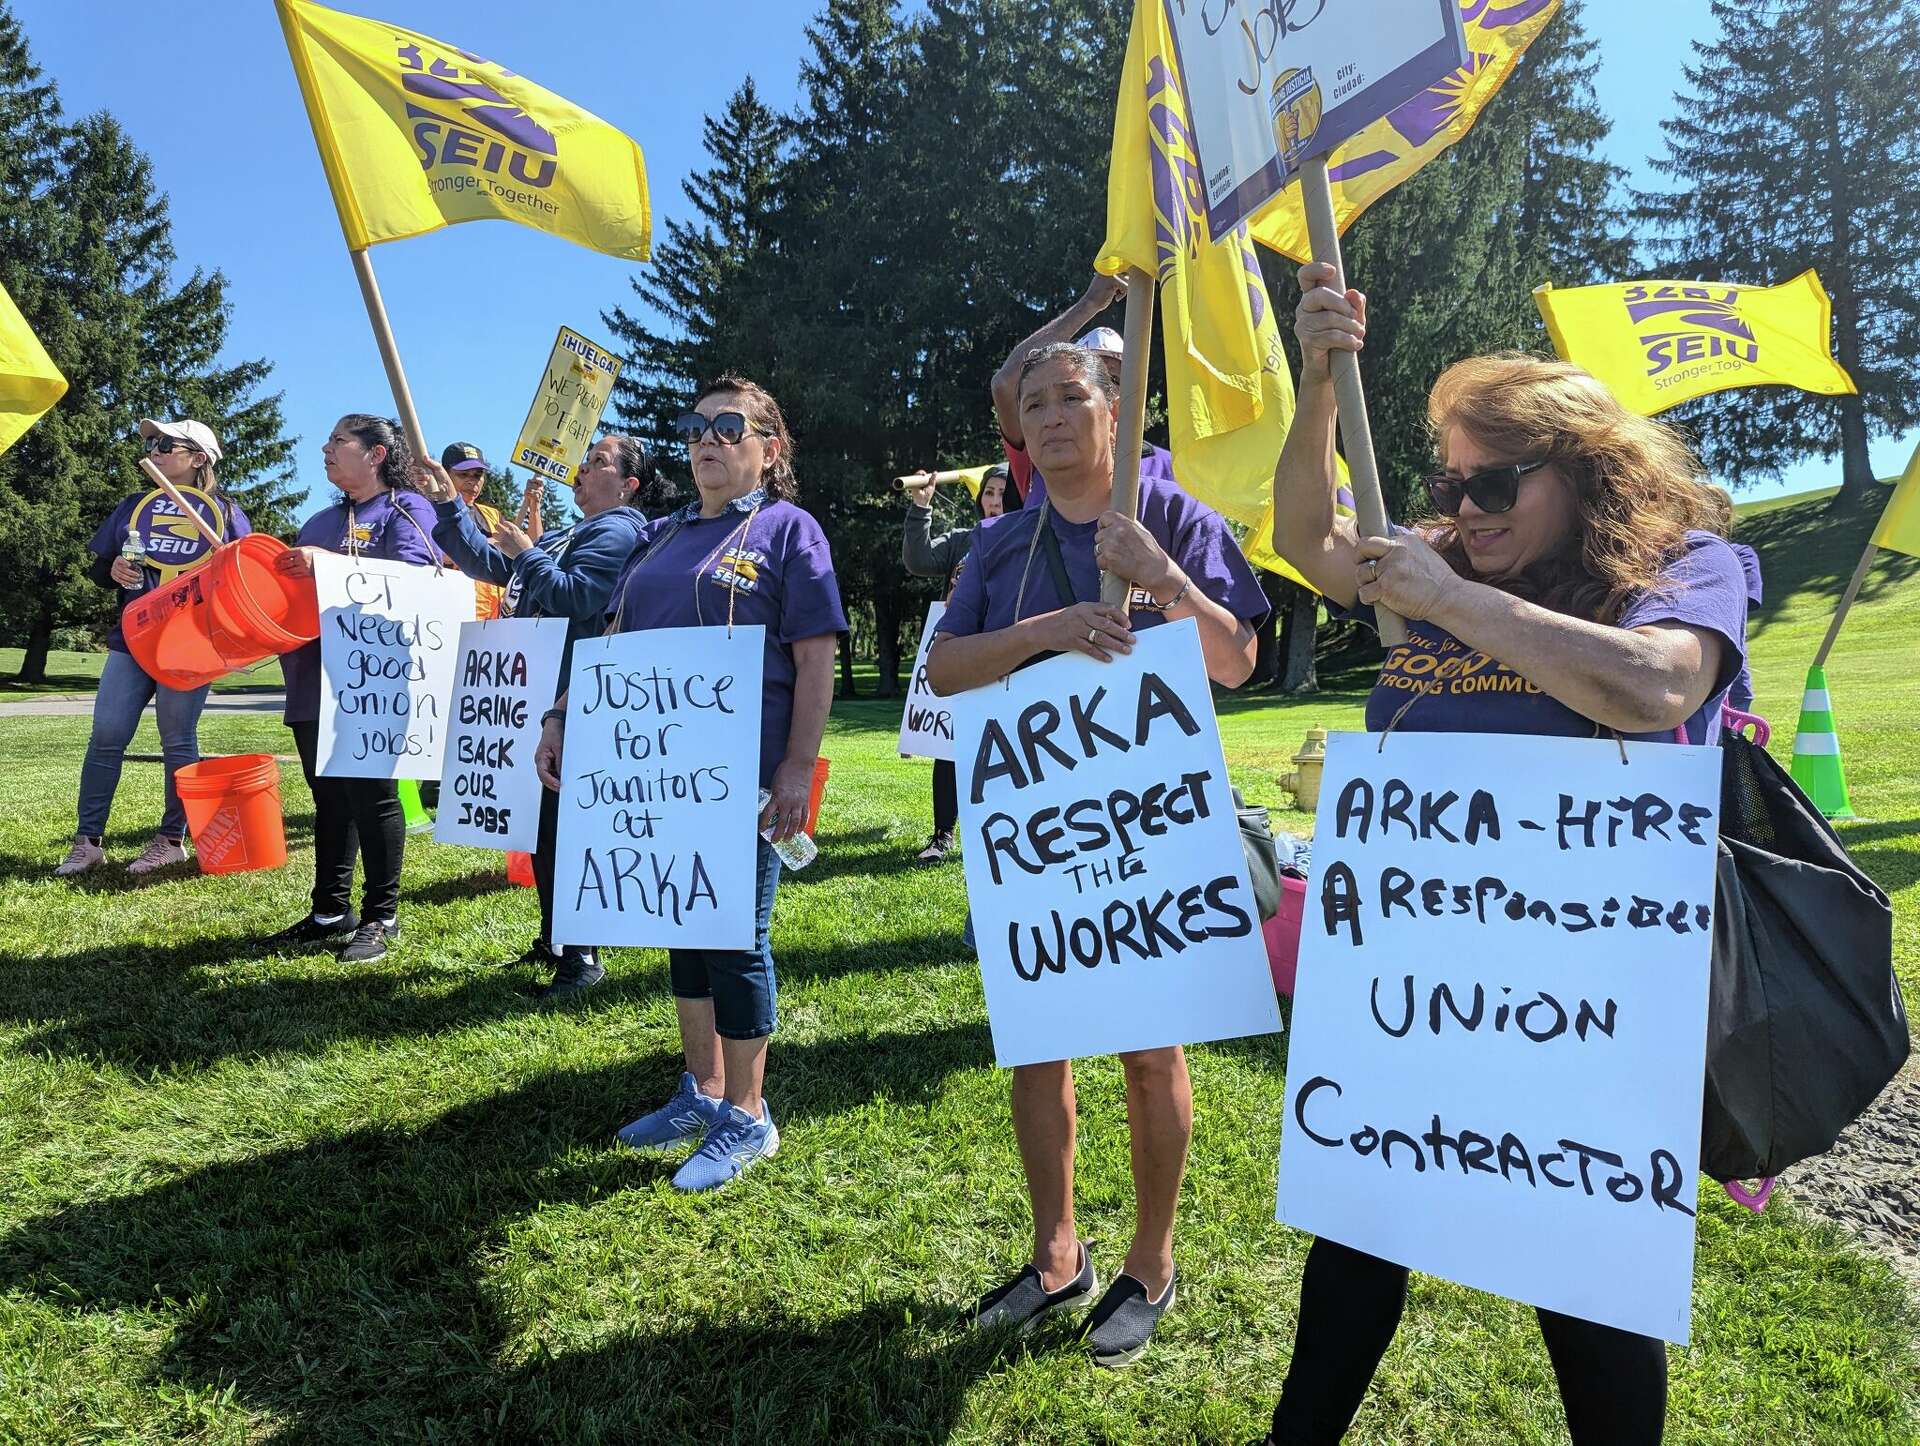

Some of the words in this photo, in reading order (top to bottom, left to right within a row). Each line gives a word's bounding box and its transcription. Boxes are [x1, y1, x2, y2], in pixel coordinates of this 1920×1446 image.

[1333, 74, 1366, 100] Ciudad:
[1336, 62, 1357, 81] City:
[413, 122, 558, 189] SEIU
[487, 178, 559, 215] Together
[1647, 335, 1759, 377] SEIU
[549, 369, 574, 397] WE
[576, 383, 604, 416] READY
[1654, 363, 1712, 391] Stronger
[544, 395, 559, 416] TO
[557, 411, 592, 446] FIGHT
[521, 449, 569, 480] STRIKE!
[147, 539, 199, 555] SEIU
[725, 547, 766, 564] 32BJ
[346, 572, 401, 610] CT
[336, 613, 443, 650] Needs
[347, 649, 427, 690] good
[463, 650, 528, 688] ARKA
[582, 663, 736, 715] Justice
[459, 694, 528, 729] BRING
[908, 703, 955, 741] WOR
[352, 725, 434, 760] jobs!
[457, 735, 515, 770] BACK
[614, 718, 682, 760] for
[971, 672, 1202, 804] ARKA
[454, 771, 498, 801] OUR
[577, 765, 730, 809] Janitors
[457, 802, 511, 835] JOBS
[613, 809, 663, 839] at
[981, 770, 1213, 885] RESPECT
[1335, 777, 1501, 847] ARKA
[575, 847, 719, 926] ARKA
[1063, 847, 1148, 893] THE
[1321, 860, 1363, 947] A
[1008, 875, 1253, 983] WORKES
